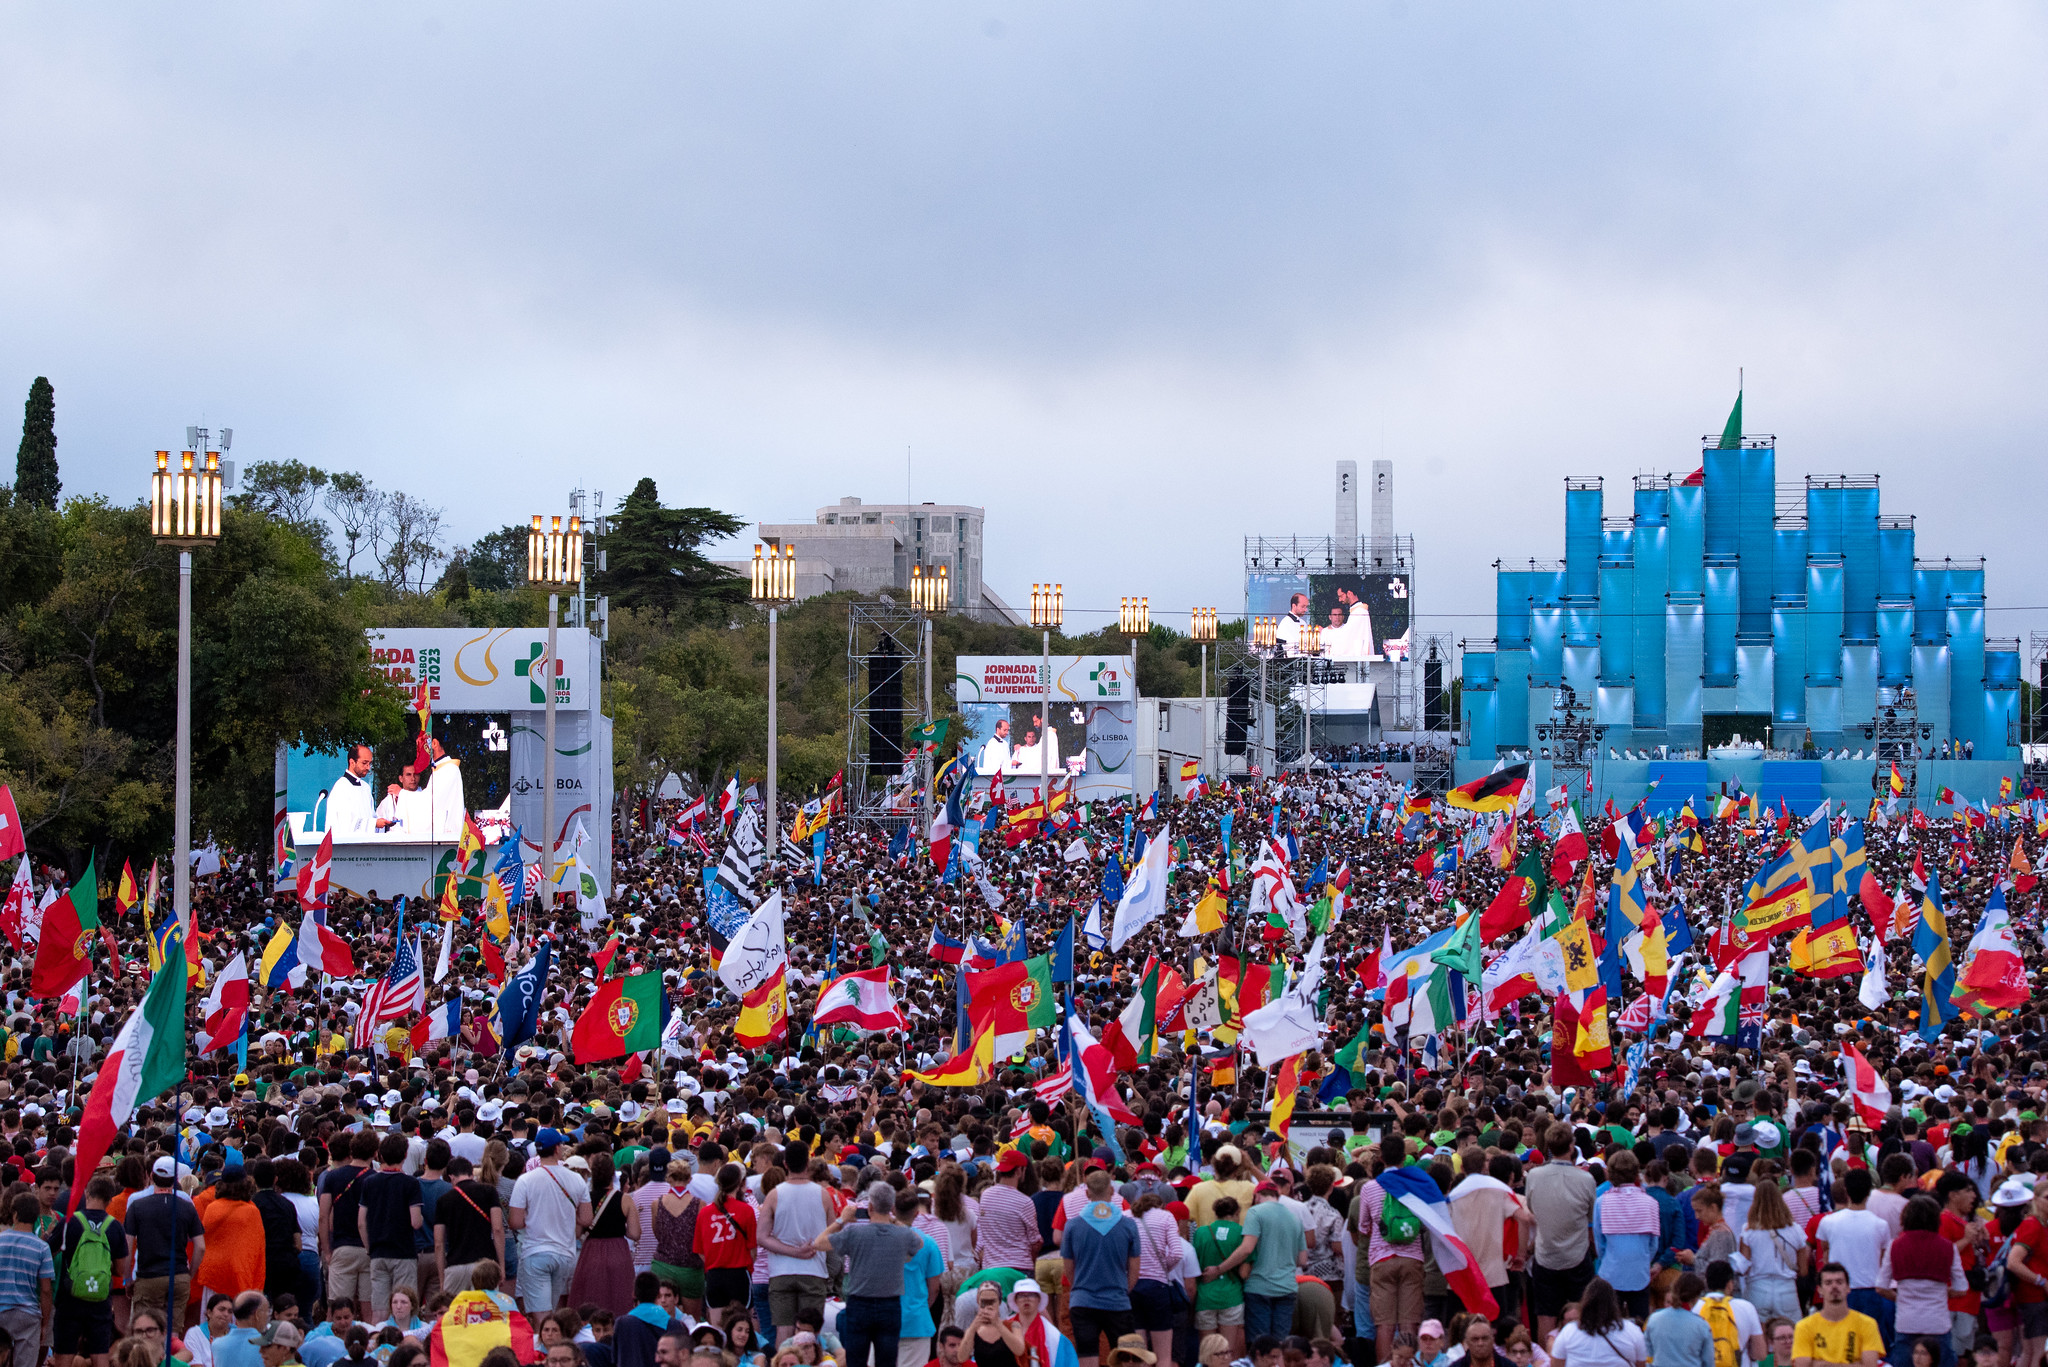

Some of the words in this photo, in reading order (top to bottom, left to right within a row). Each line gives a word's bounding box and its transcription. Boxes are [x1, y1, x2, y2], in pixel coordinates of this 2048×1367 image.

[428, 648, 441, 683] 2023
[985, 664, 1037, 674] JORNADA
[555, 680, 570, 691] MJ
[984, 675, 1037, 685] MUNDIAL
[555, 696, 570, 704] 023
[1101, 734, 1128, 742] LISBOA
[536, 778, 583, 790] LBOA
[517, 973, 538, 1022] foc
[710, 1221, 738, 1243] 23
